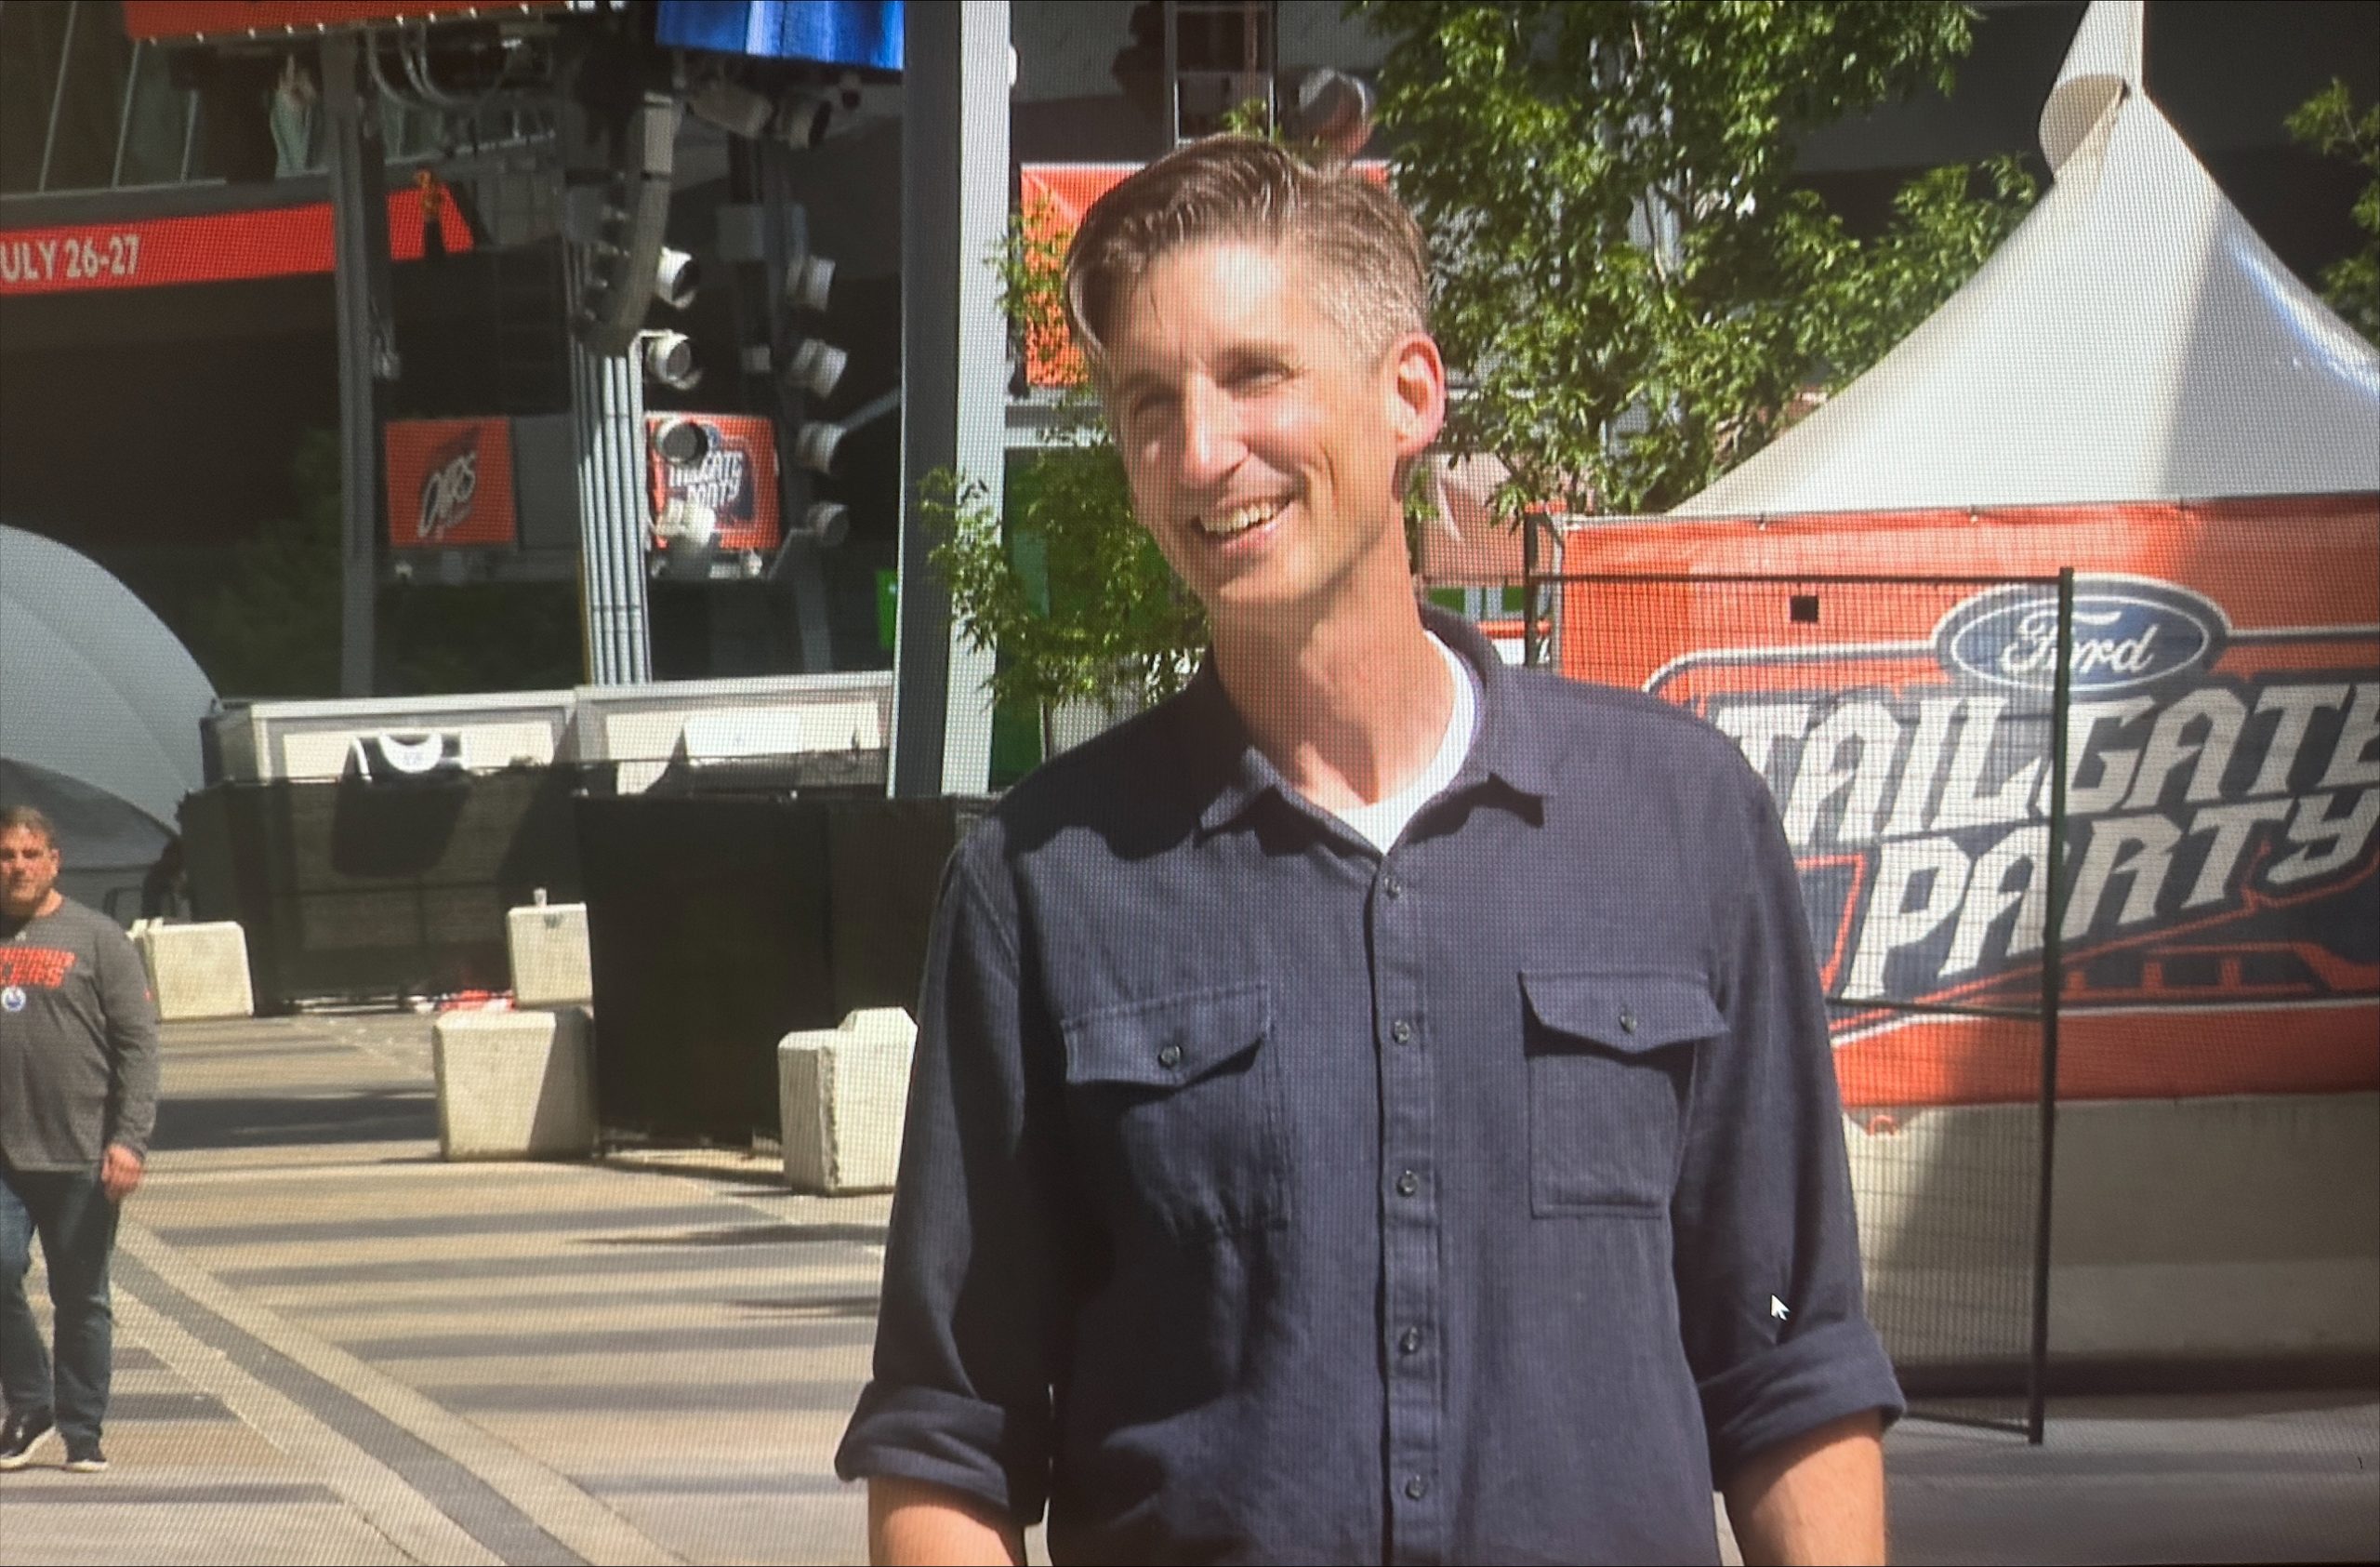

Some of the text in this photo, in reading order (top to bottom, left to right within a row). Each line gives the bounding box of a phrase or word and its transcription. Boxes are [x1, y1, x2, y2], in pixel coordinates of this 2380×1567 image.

[65, 233, 139, 279] 26-27
[1716, 683, 2380, 842] TAILGATE
[1841, 789, 2380, 1002] PARTY
